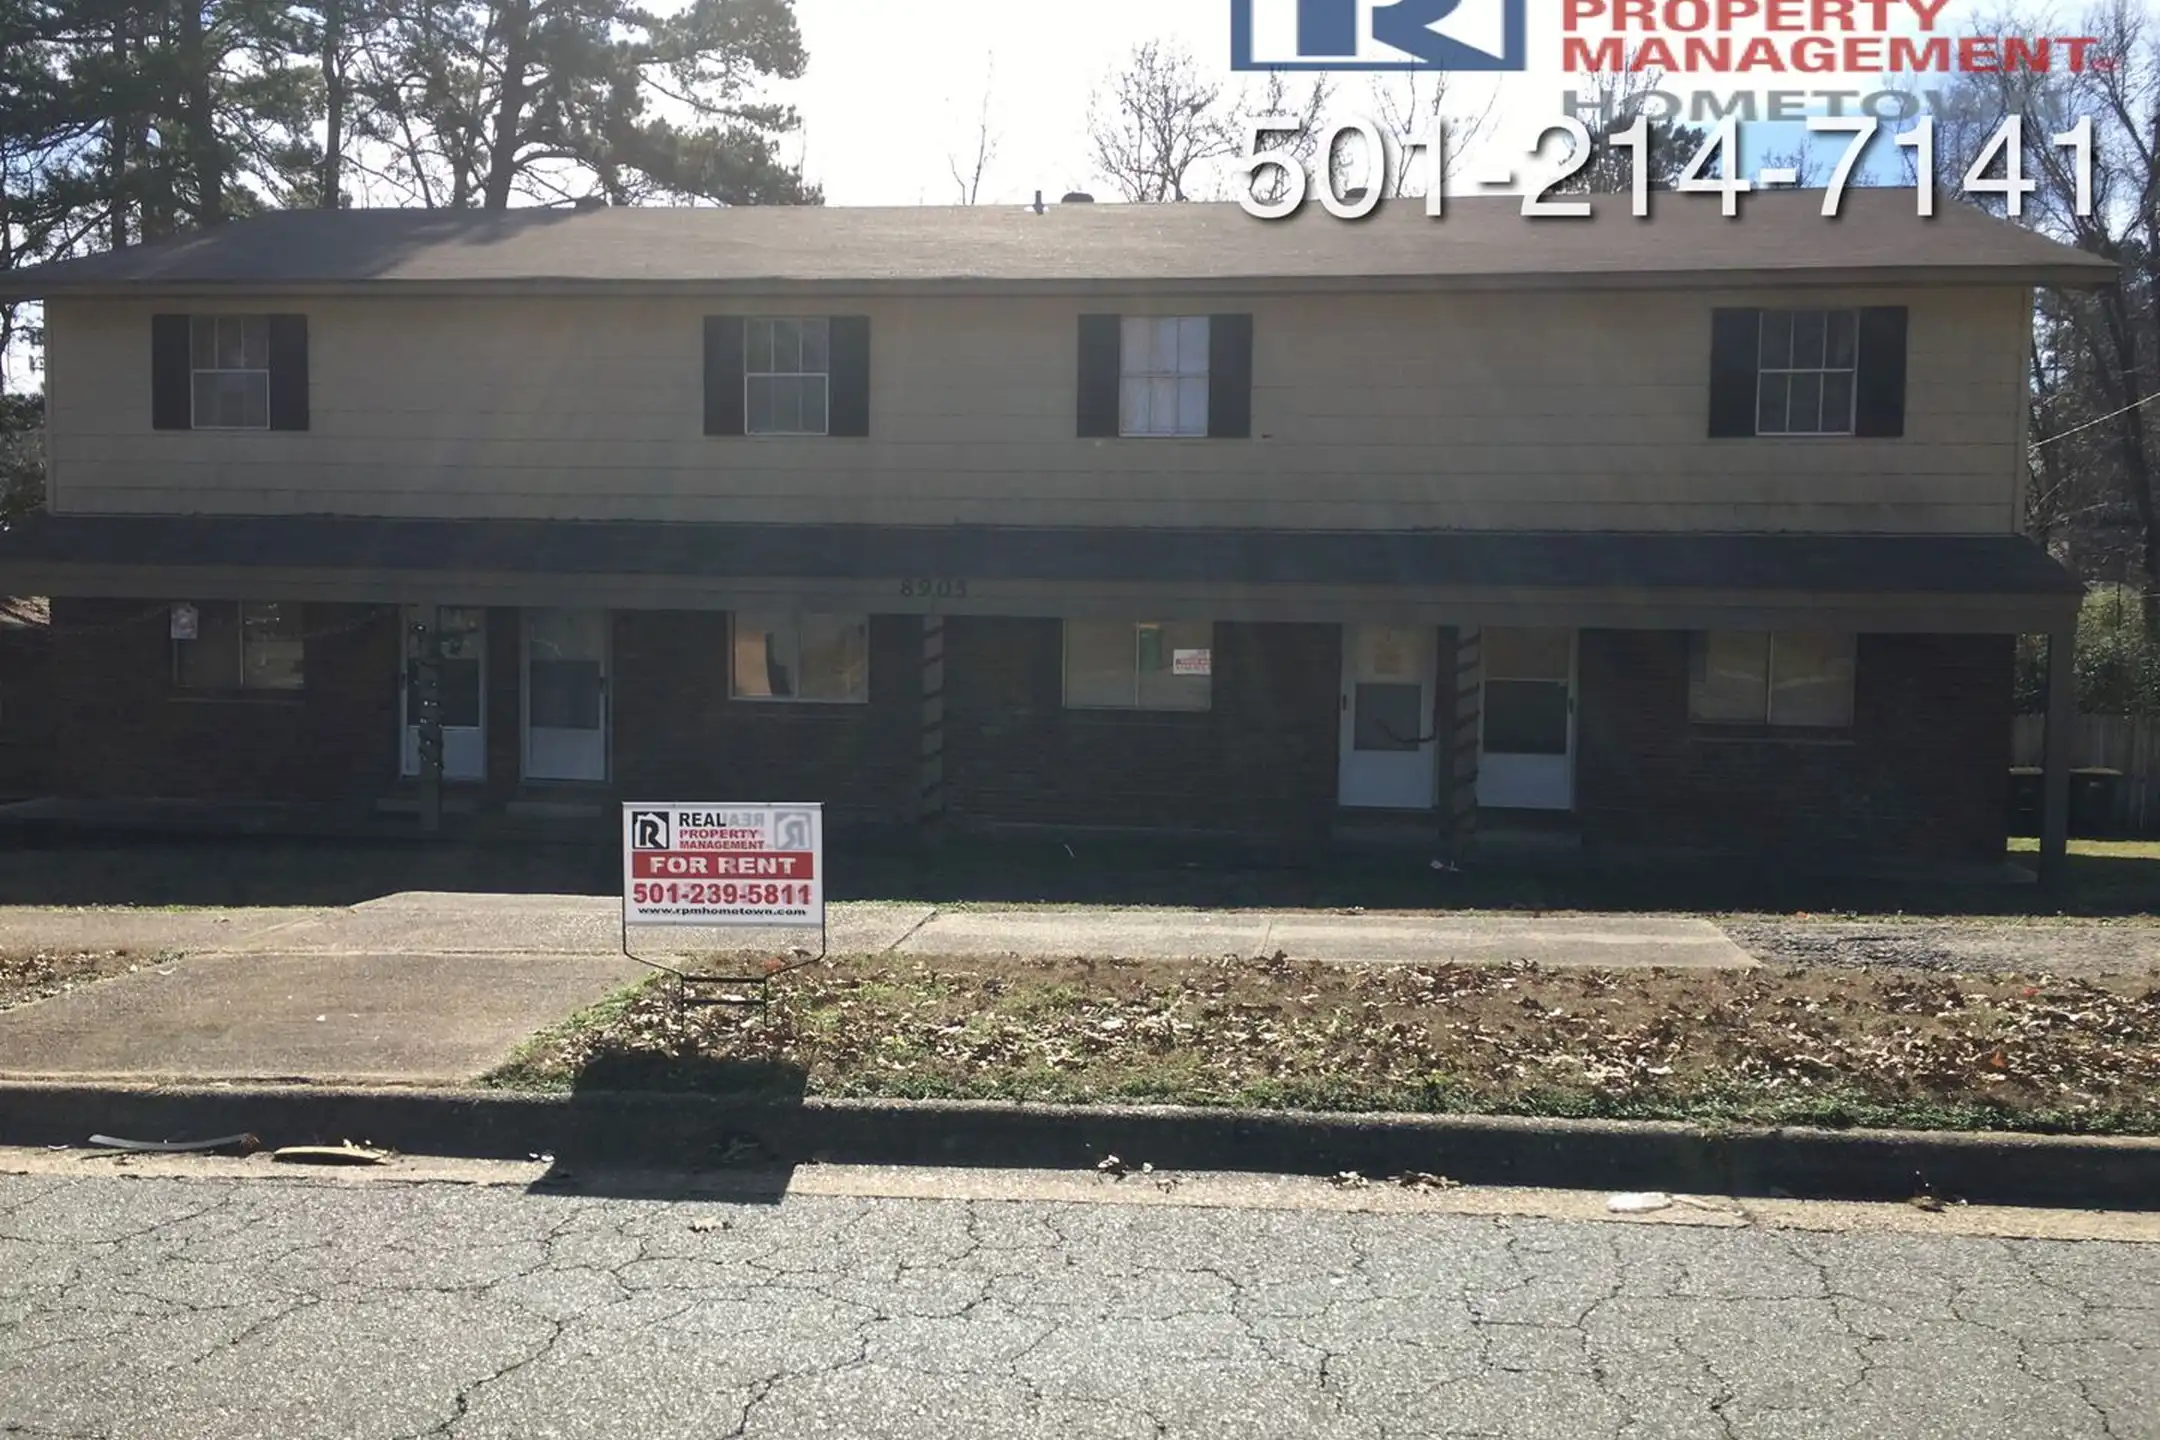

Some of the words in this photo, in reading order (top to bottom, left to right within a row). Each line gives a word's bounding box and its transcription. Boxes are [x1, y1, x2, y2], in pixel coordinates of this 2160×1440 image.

[679, 812, 727, 827] REAL
[680, 829, 759, 839] PROPERTY
[680, 840, 765, 850] MANAGEMENT
[650, 857, 709, 874] FOR
[718, 857, 796, 874] RENT
[633, 883, 811, 905] 501-239-5811
[638, 906, 807, 918] www.rpmhometown.com
